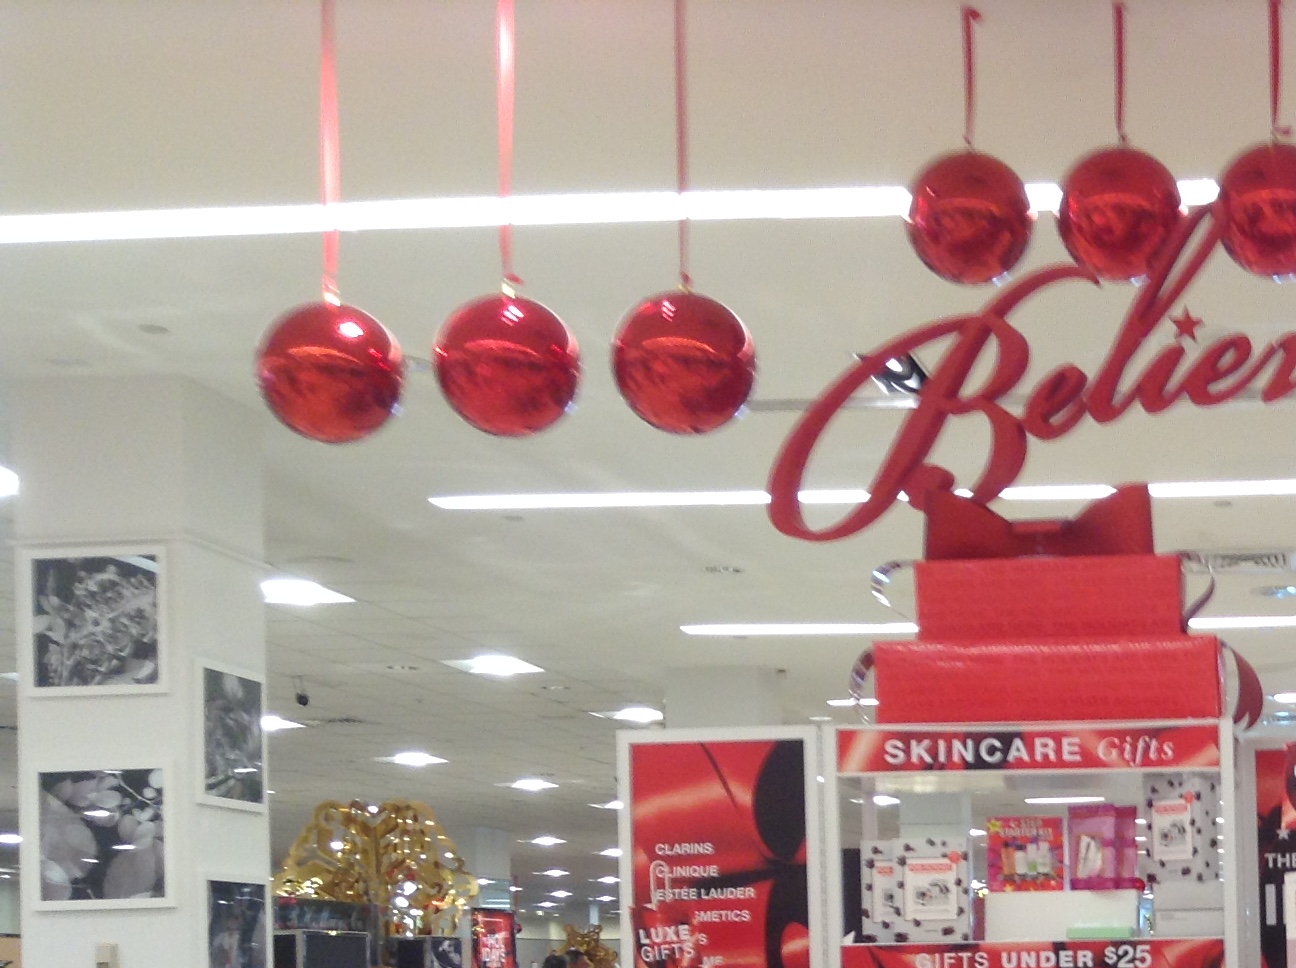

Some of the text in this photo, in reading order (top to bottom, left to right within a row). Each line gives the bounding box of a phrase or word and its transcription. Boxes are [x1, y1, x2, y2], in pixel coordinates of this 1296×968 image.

[884, 737, 1175, 767] SKINCARE Gifts
[655, 842, 715, 855] CLARINS
[655, 865, 719, 877] CLINIQUE
[656, 886, 756, 900] ESTÉE LAUDER
[638, 925, 691, 944] LUXE
[641, 943, 695, 962] GIFTS
[1001, 951, 1094, 968] UNDER
[1104, 945, 1153, 968] $25
